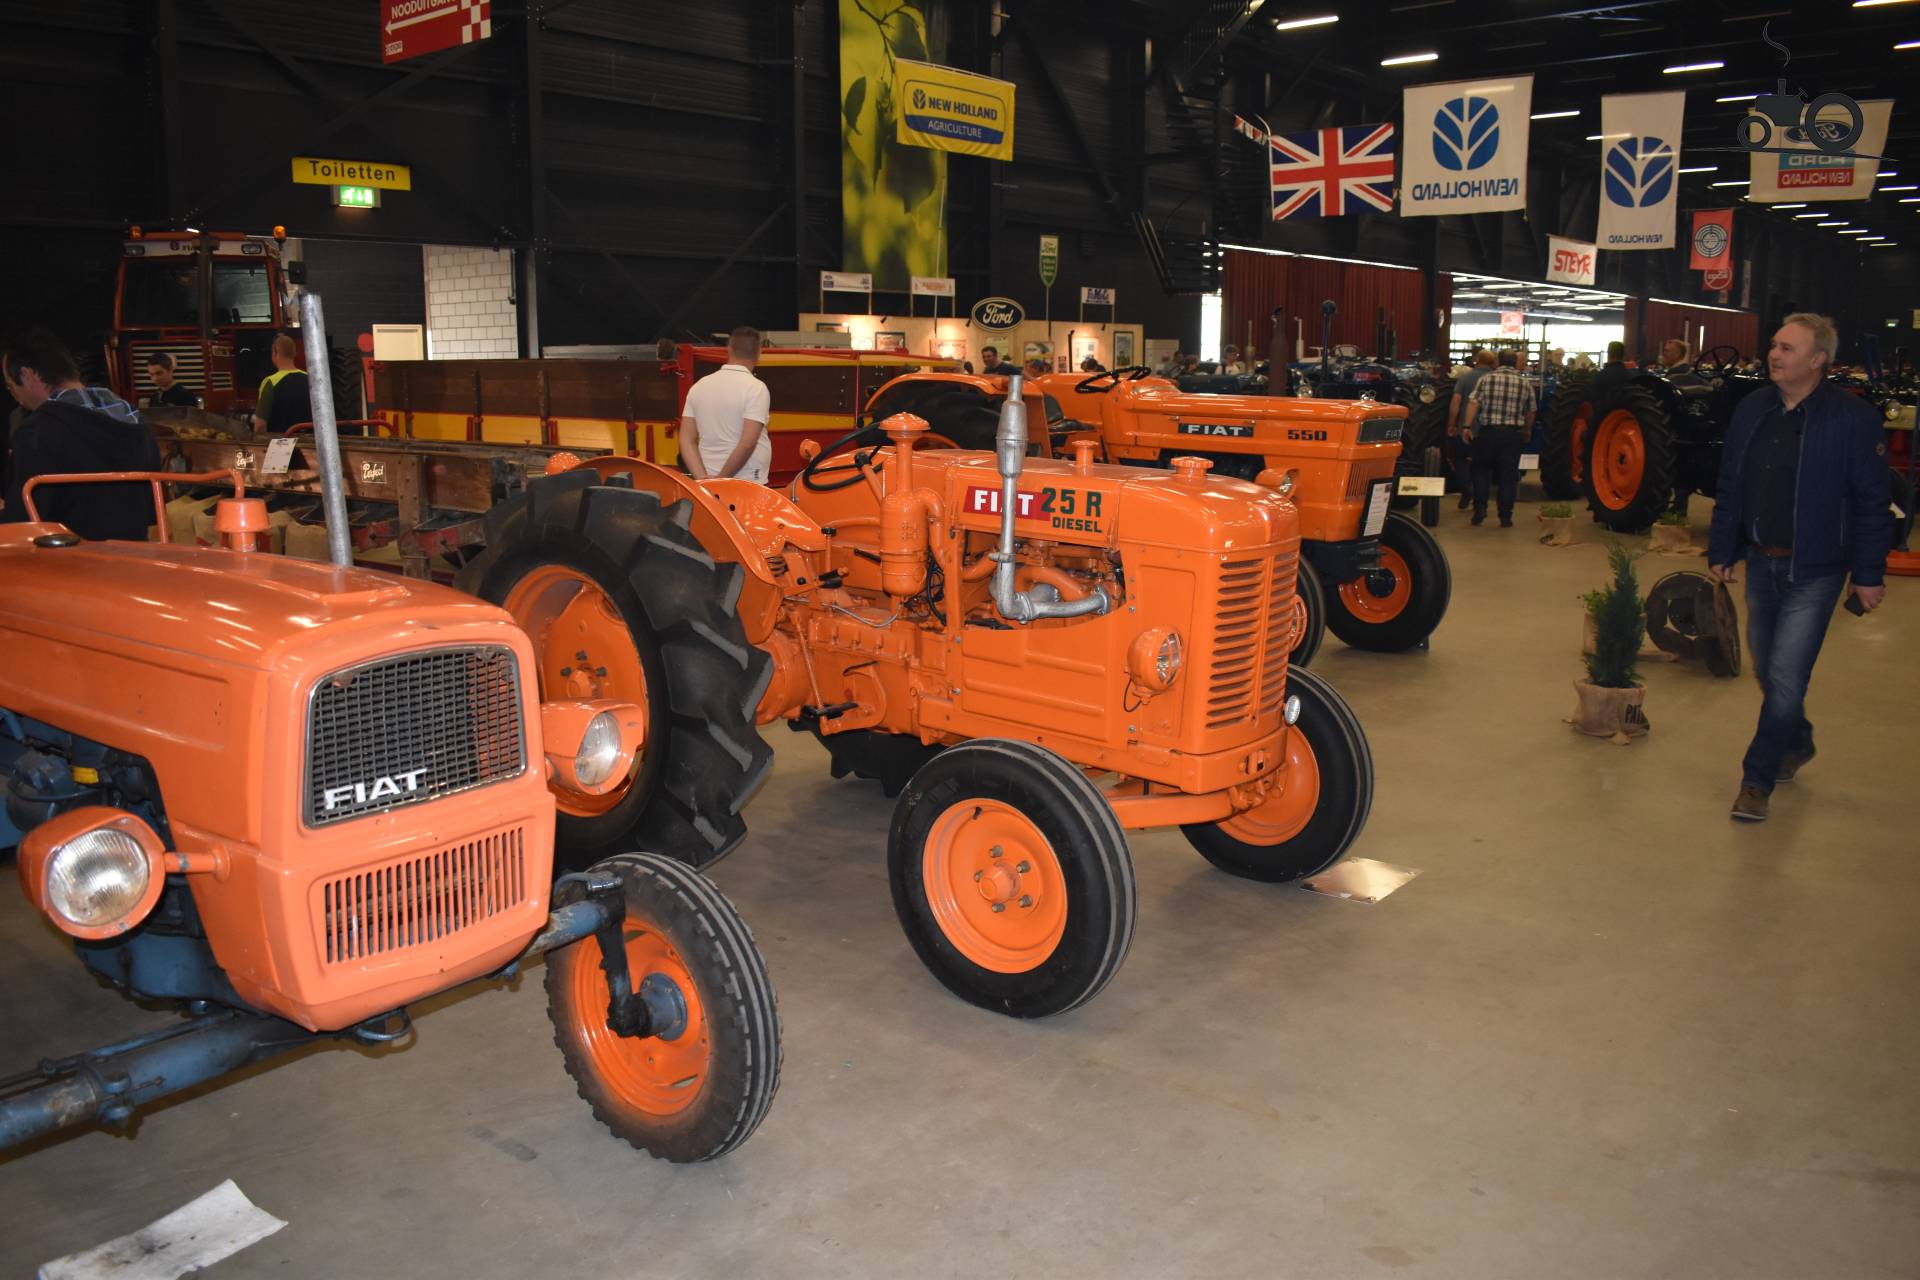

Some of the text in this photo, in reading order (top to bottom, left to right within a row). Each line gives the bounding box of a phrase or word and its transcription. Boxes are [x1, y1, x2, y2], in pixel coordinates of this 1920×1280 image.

[928, 97, 997, 120] NEW HOLLAND
[928, 121, 982, 138] AGRICULTURE
[309, 160, 395, 181] Toiletten
[1554, 249, 1592, 275] STEYR
[982, 303, 1014, 324] Ford
[1187, 425, 1244, 436] FIAT
[1287, 429, 1327, 441] 550
[974, 487, 1102, 517] FIT 25 R
[1052, 516, 1103, 533] DIESEL
[324, 768, 427, 810] FIAT
